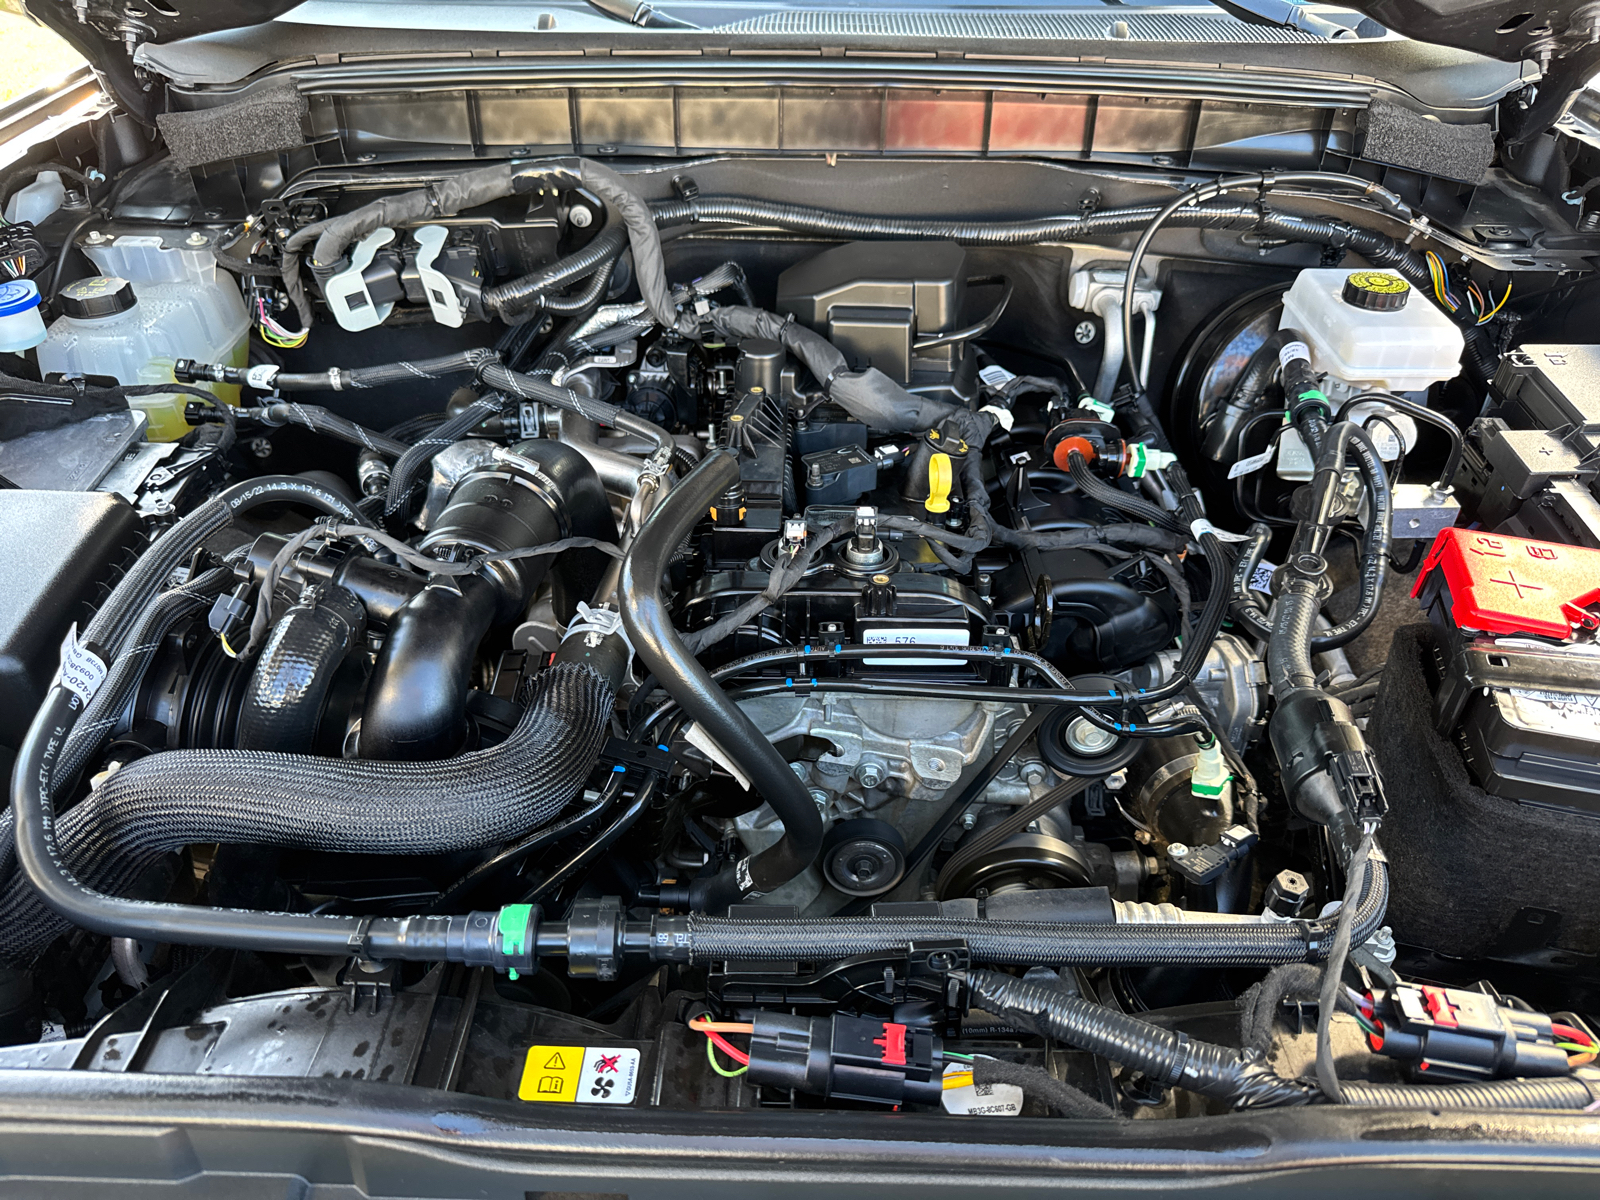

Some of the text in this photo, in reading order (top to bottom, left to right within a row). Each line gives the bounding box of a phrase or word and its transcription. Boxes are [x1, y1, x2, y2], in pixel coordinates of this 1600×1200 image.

[267, 482, 288, 491] 14.3
[290, 483, 298, 491] X
[302, 485, 321, 497] 17.6
[962, 1026, 988, 1035] (10mm)
